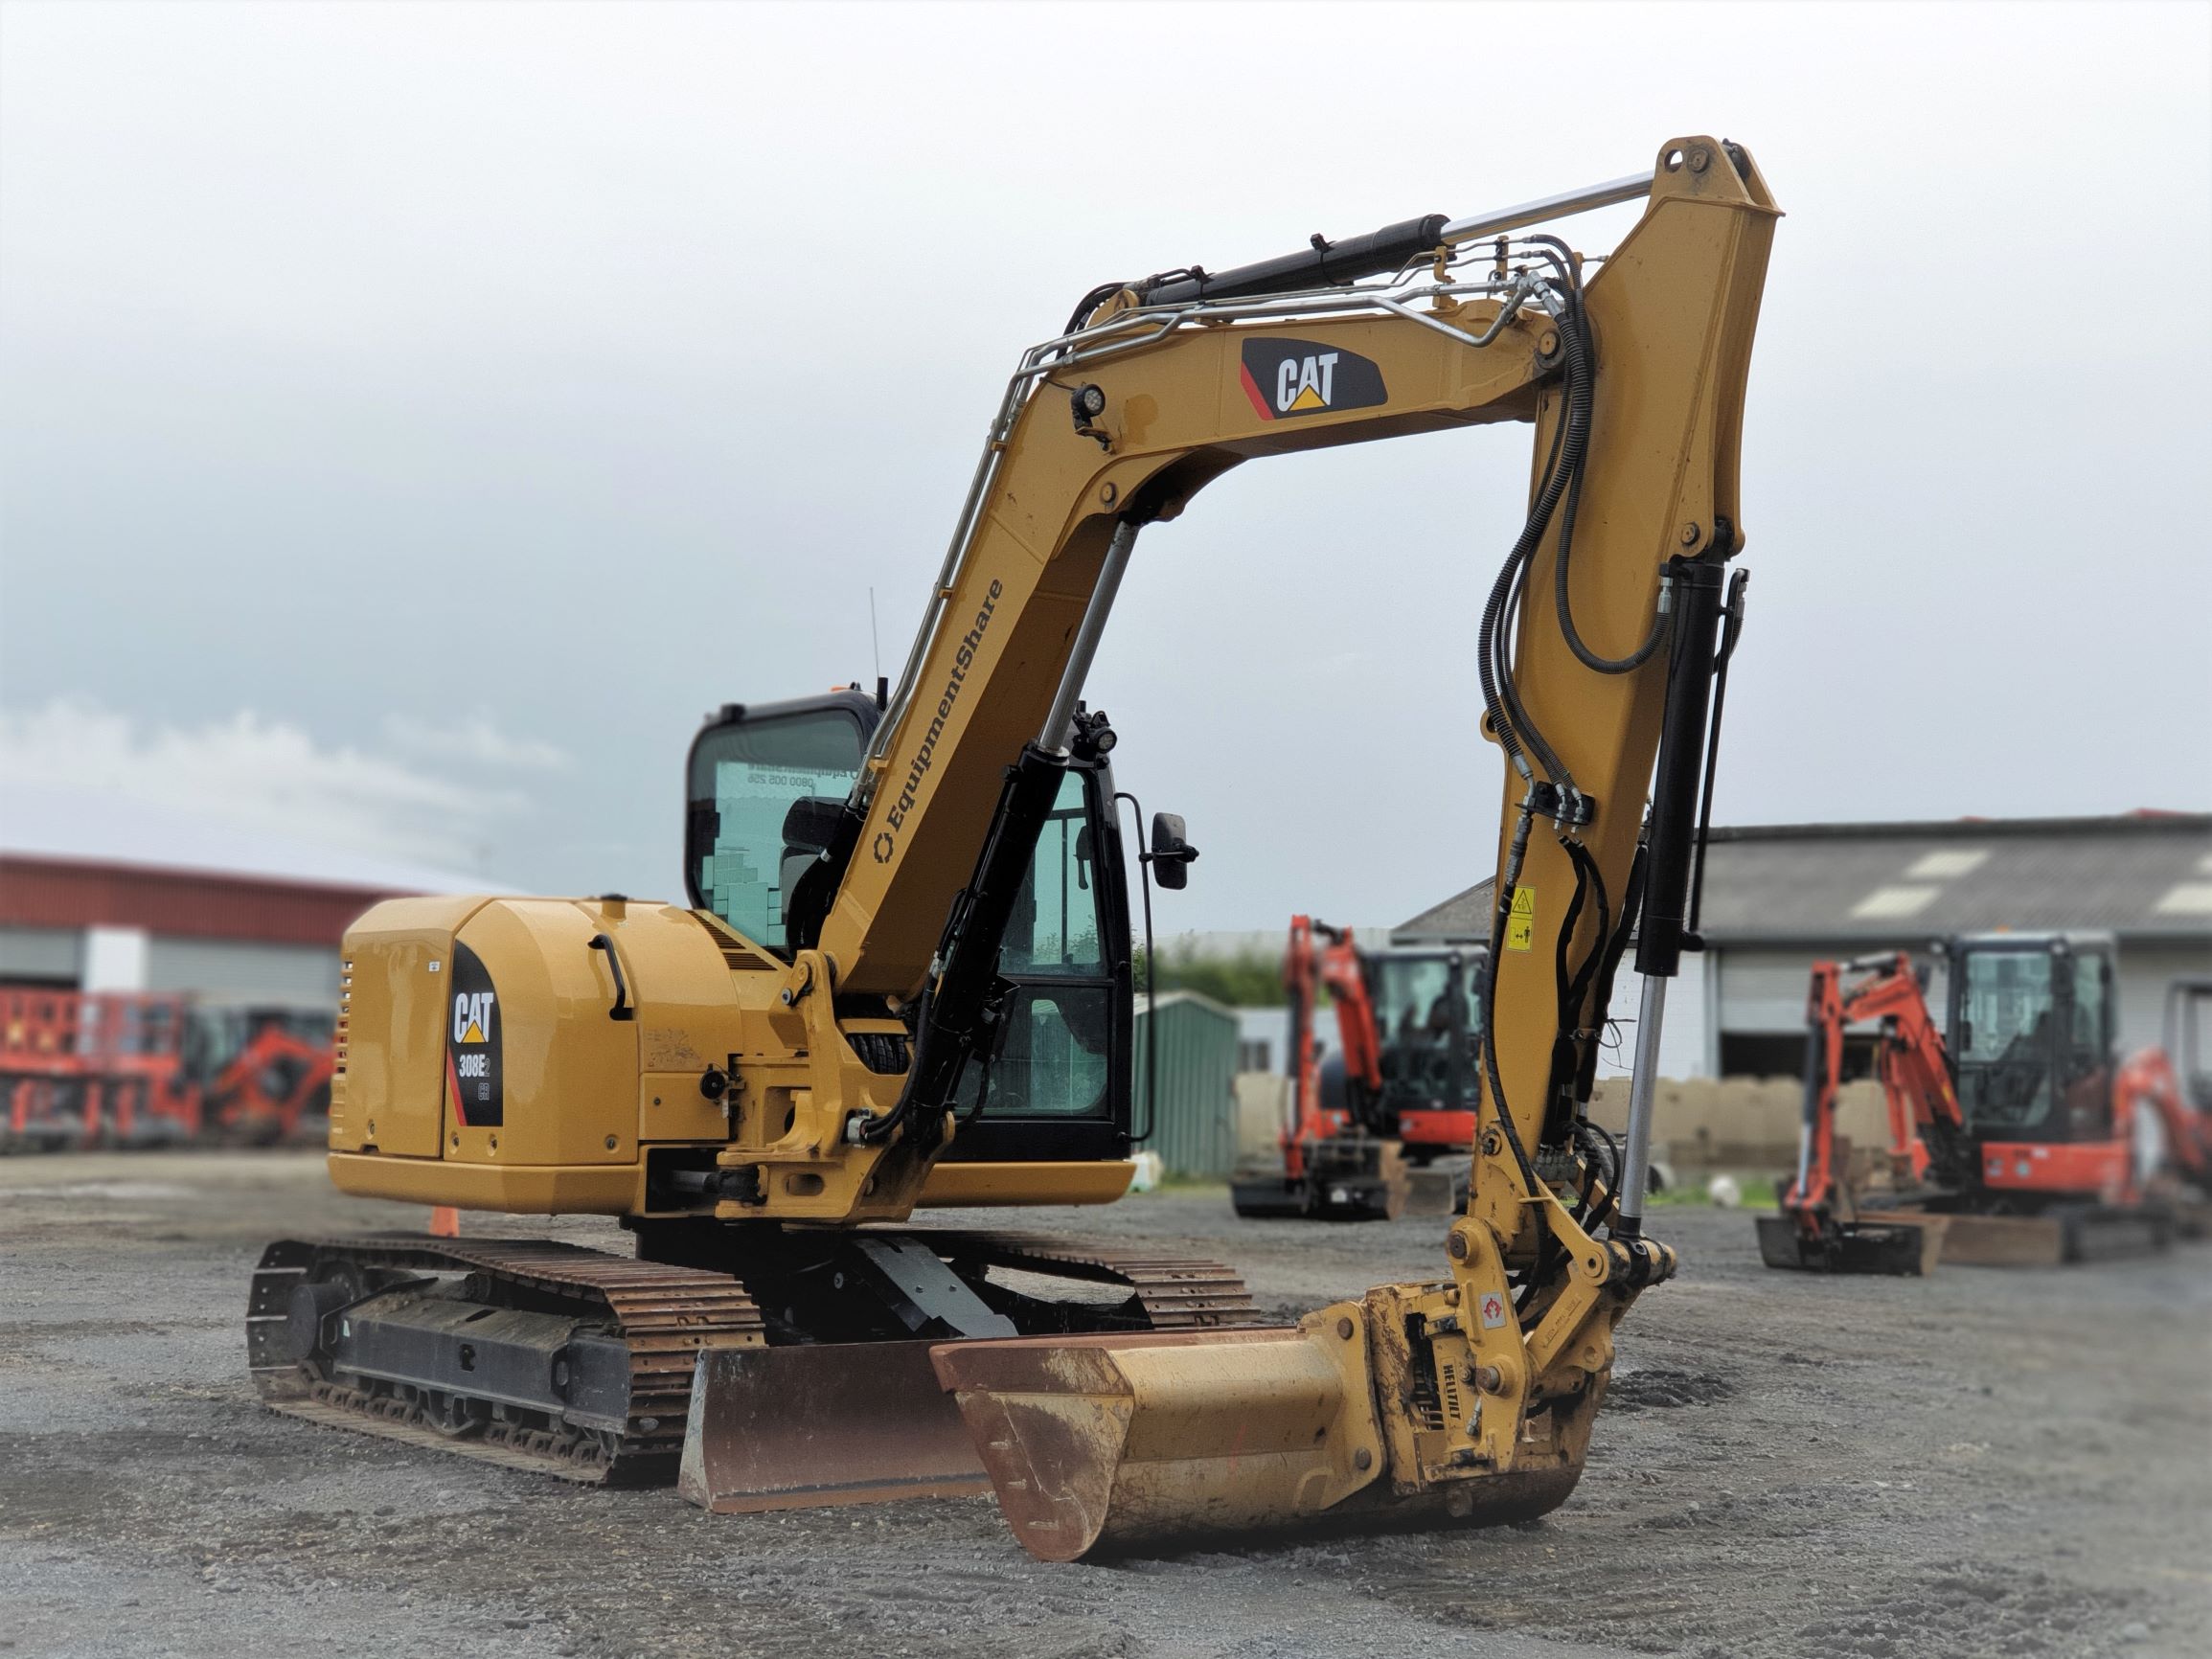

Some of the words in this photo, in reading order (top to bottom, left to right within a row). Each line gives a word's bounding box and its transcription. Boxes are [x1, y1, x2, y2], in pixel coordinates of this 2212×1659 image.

[1277, 352, 1338, 412] CAT
[886, 578, 1003, 832] EquipmentShare
[454, 992, 493, 1043] CAT
[459, 1054, 490, 1078] 308E2
